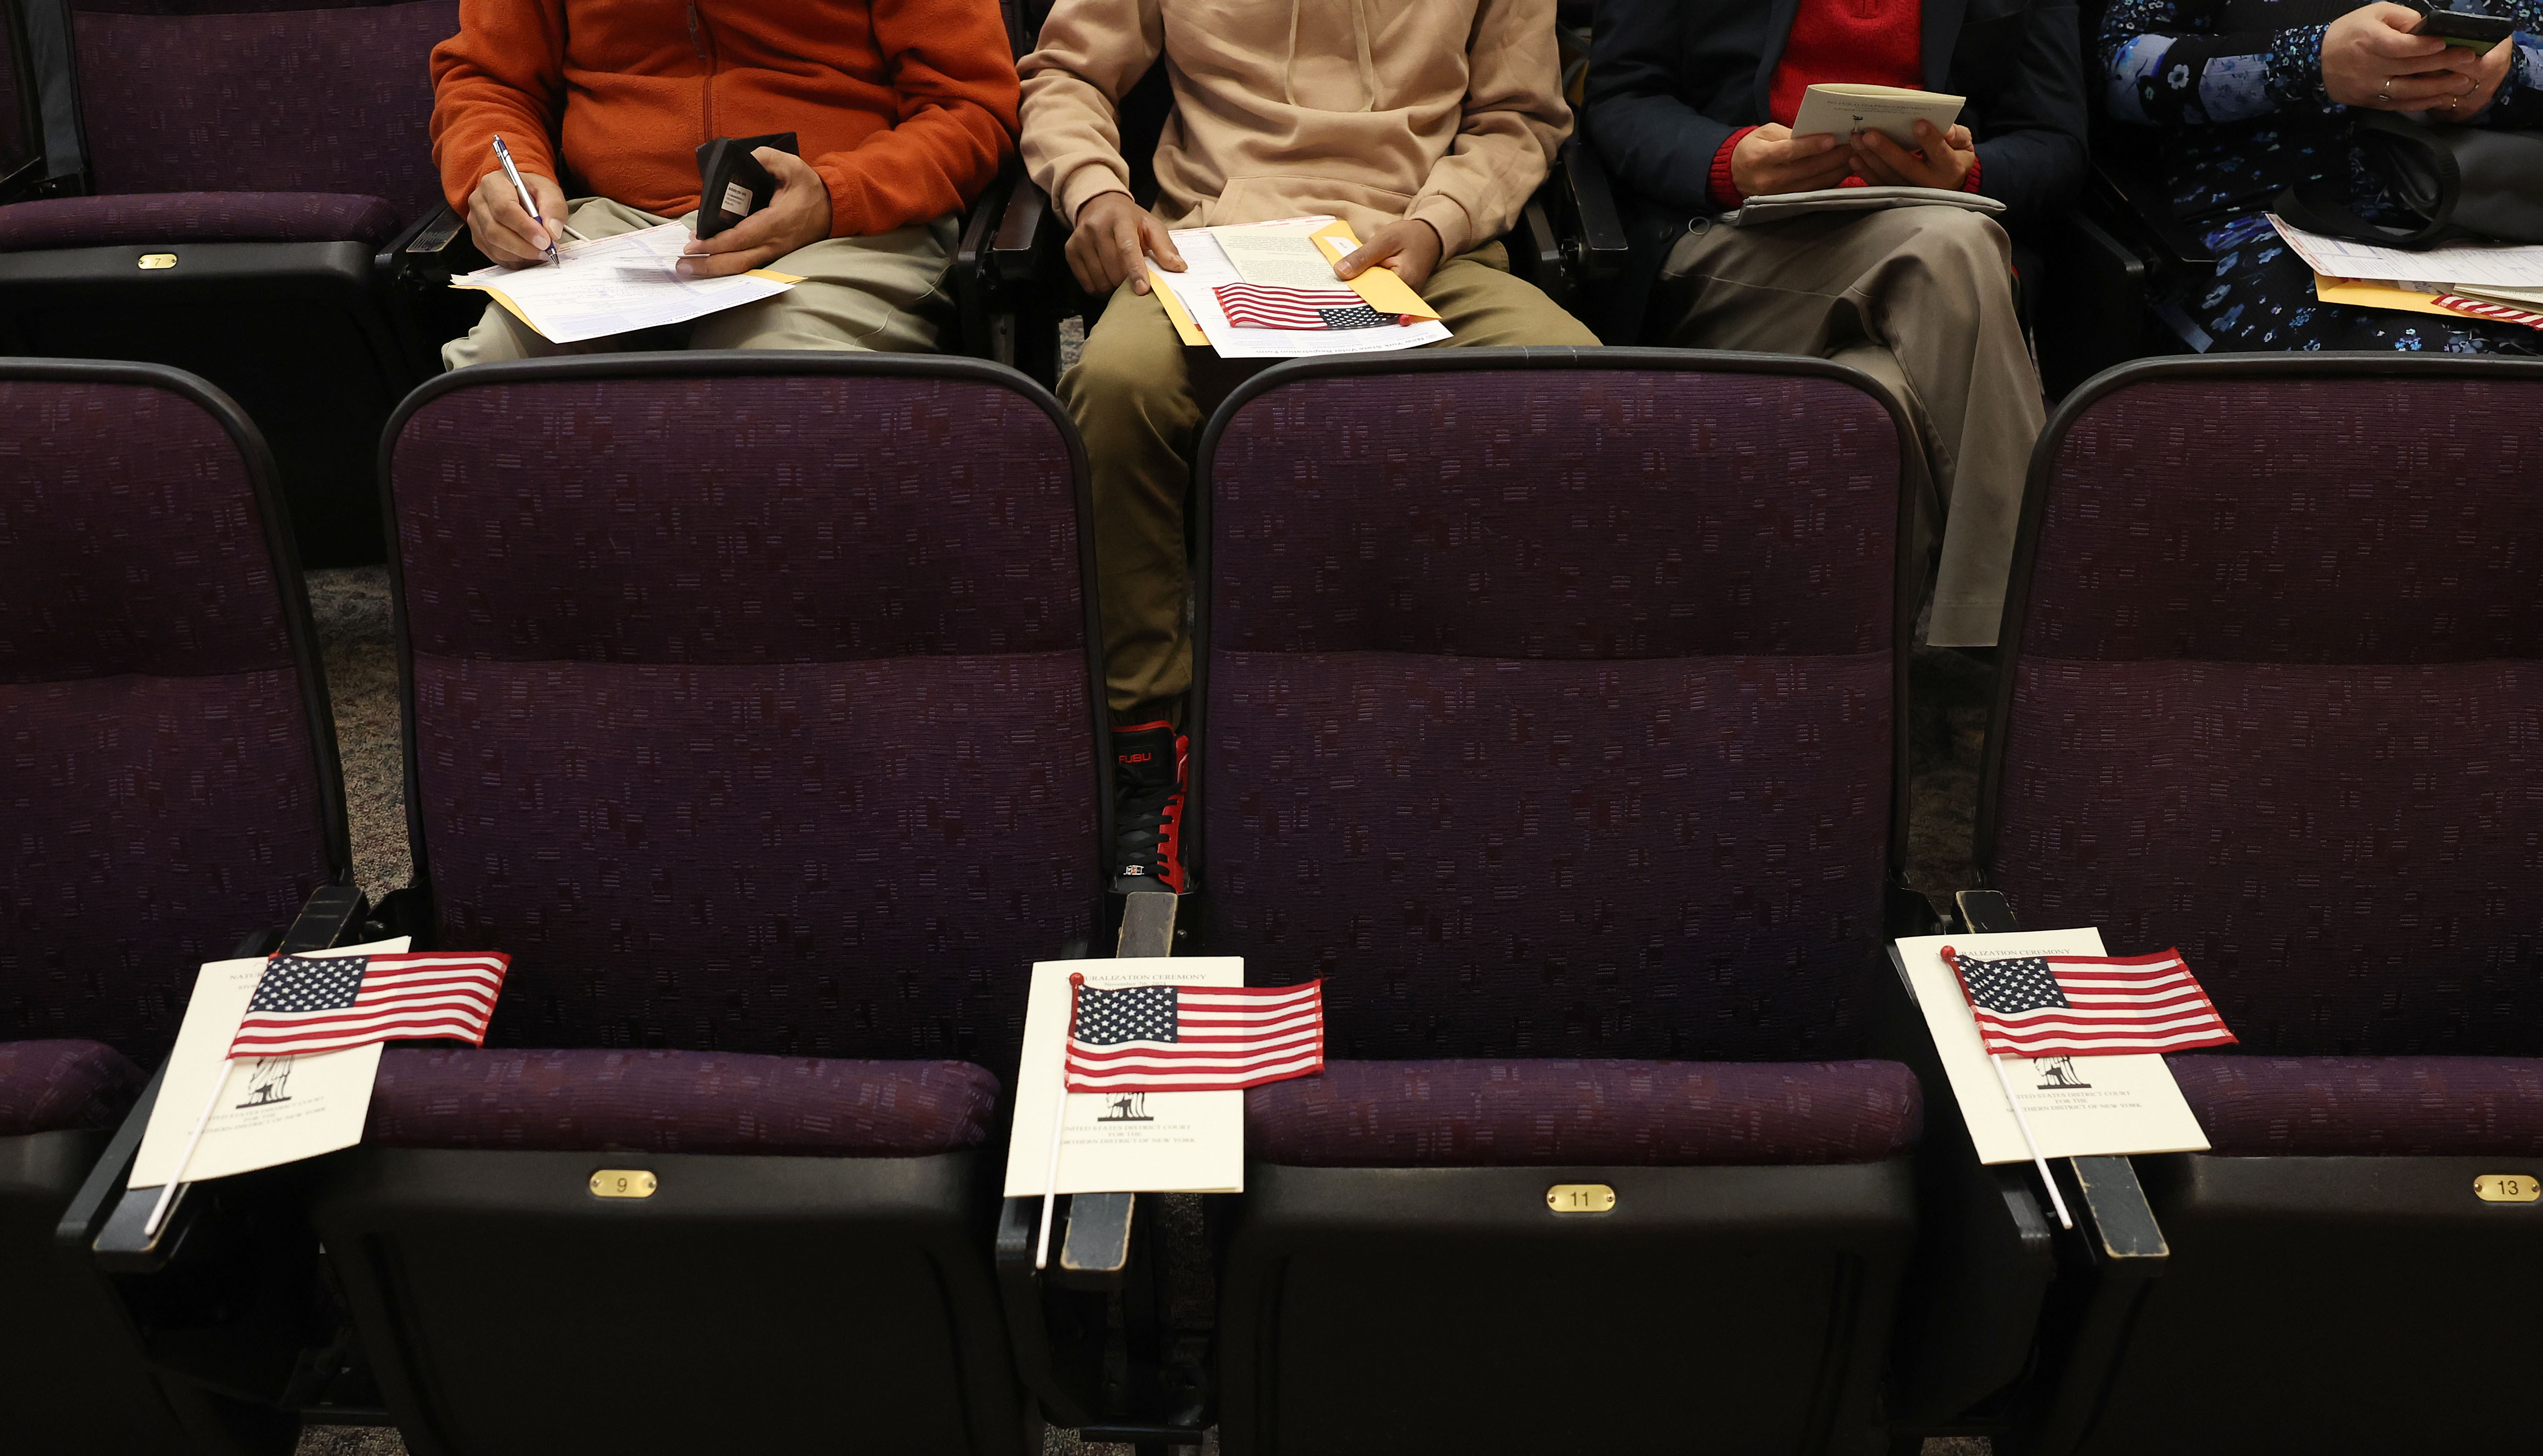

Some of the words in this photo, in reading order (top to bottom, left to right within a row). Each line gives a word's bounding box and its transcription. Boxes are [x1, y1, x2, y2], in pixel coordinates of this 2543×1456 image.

[1119, 753, 1152, 764] FUBU
[617, 1178, 627, 1193] 9
[2498, 1180, 2519, 1195] 13
[1570, 1191, 1588, 1206] 11
